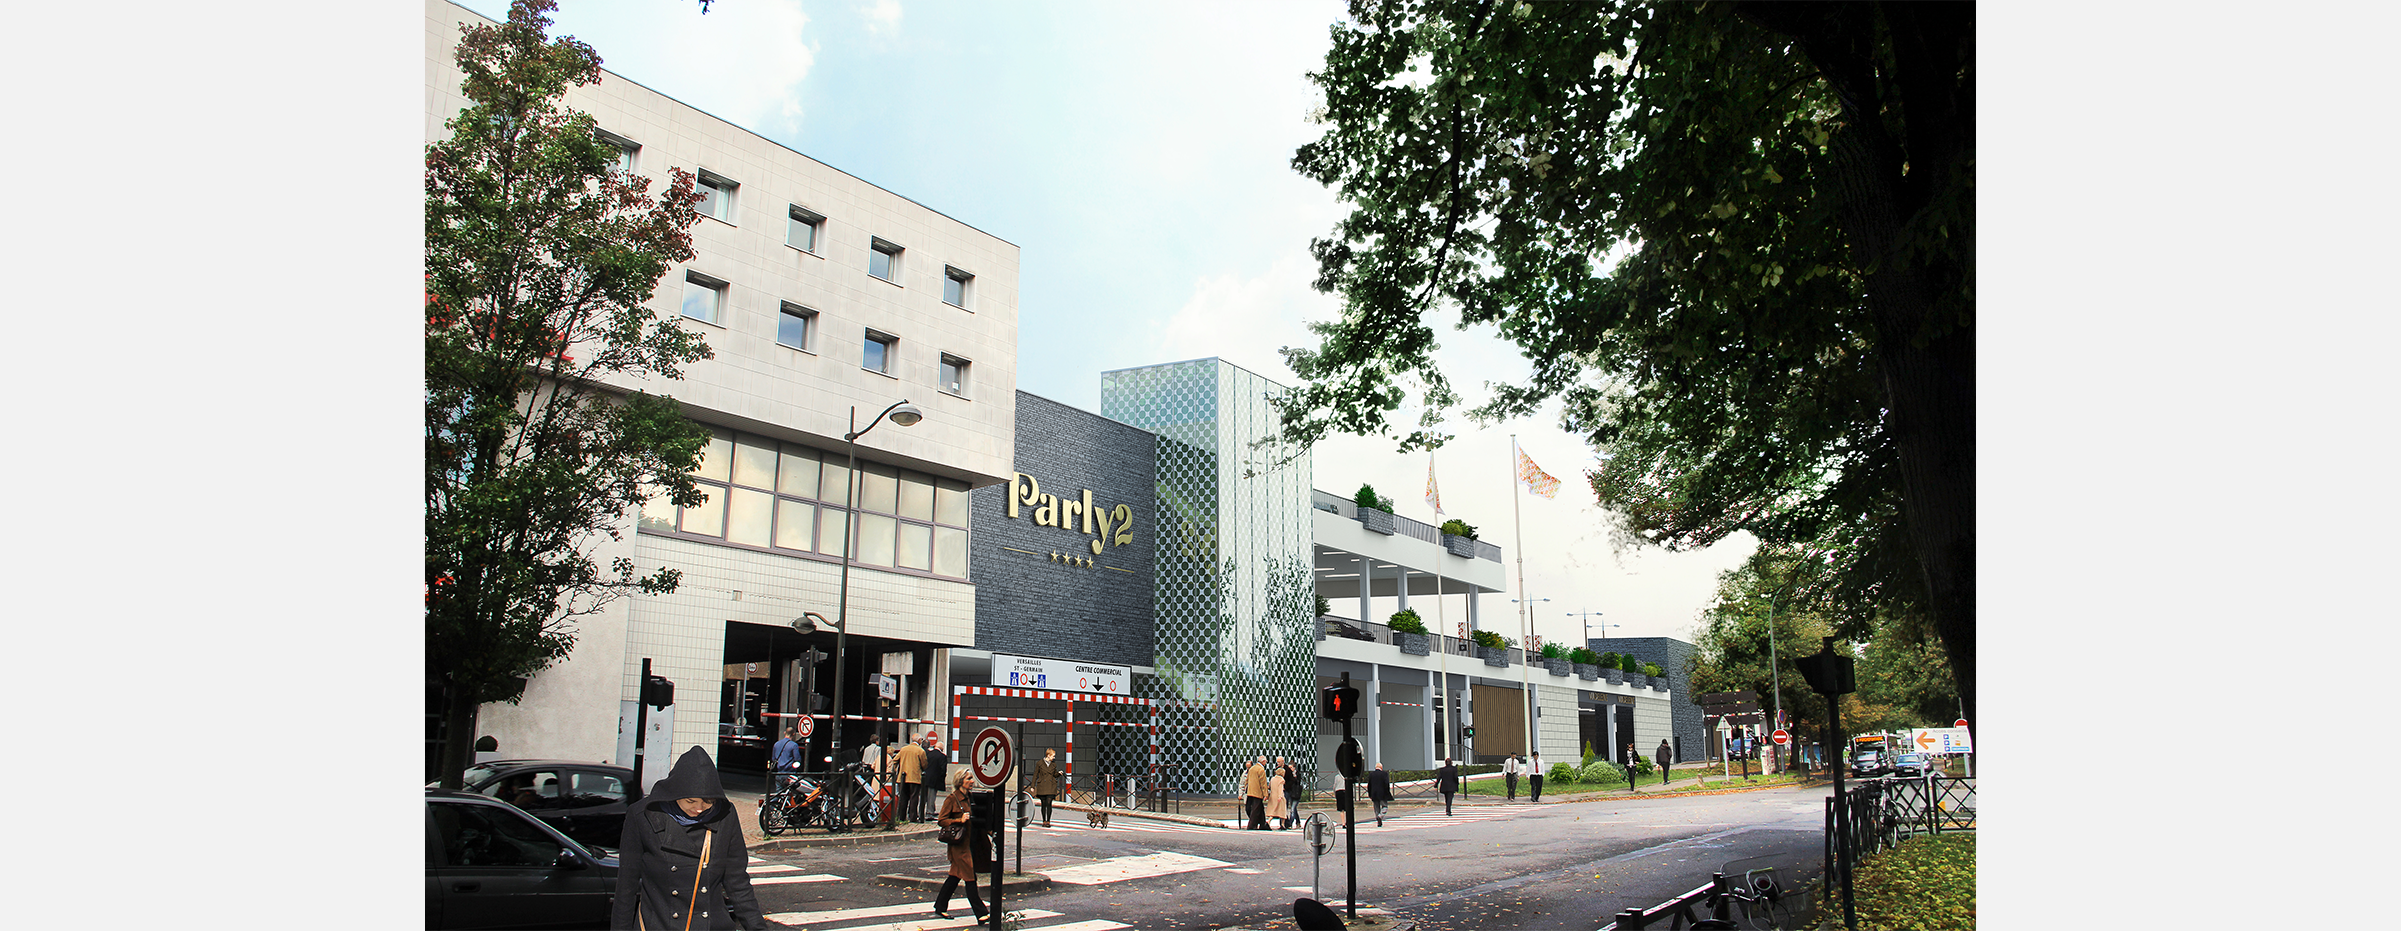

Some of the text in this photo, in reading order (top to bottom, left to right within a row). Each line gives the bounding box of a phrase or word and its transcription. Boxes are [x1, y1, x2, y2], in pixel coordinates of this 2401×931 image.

[1007, 471, 1134, 555] Parly2
[1016, 658, 1042, 666] VERSAILLES
[1023, 665, 1043, 673] GERMAIN
[1075, 665, 1122, 676] CENTRE COMMERCIAL
